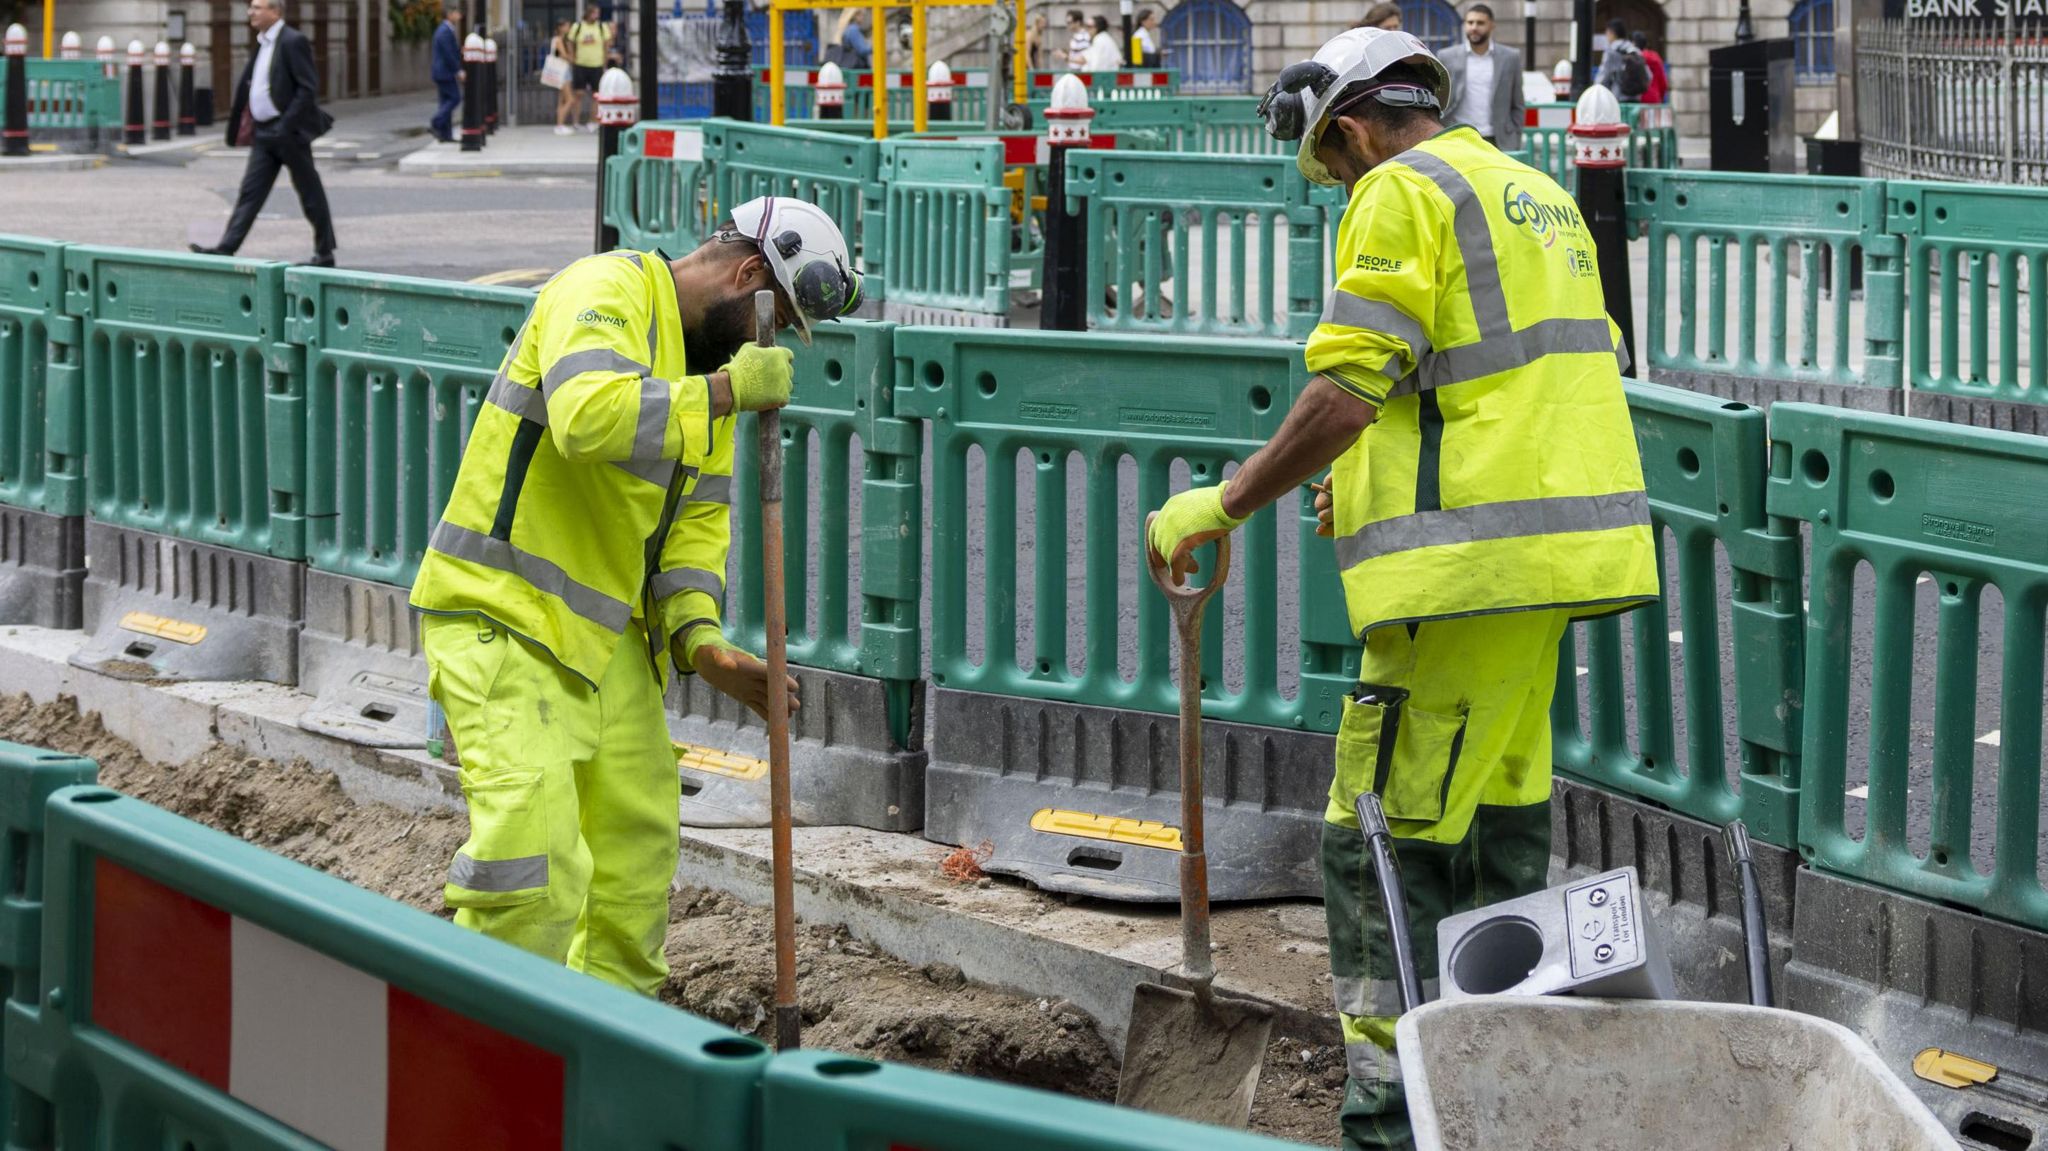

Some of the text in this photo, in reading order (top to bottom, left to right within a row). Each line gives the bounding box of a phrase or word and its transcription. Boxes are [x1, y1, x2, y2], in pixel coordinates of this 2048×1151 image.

[1908, 0, 2048, 18] BANK STA
[1357, 254, 1402, 269] PEOPLE
[1610, 902, 1621, 943] Transport
[1619, 895, 1630, 944] for London
